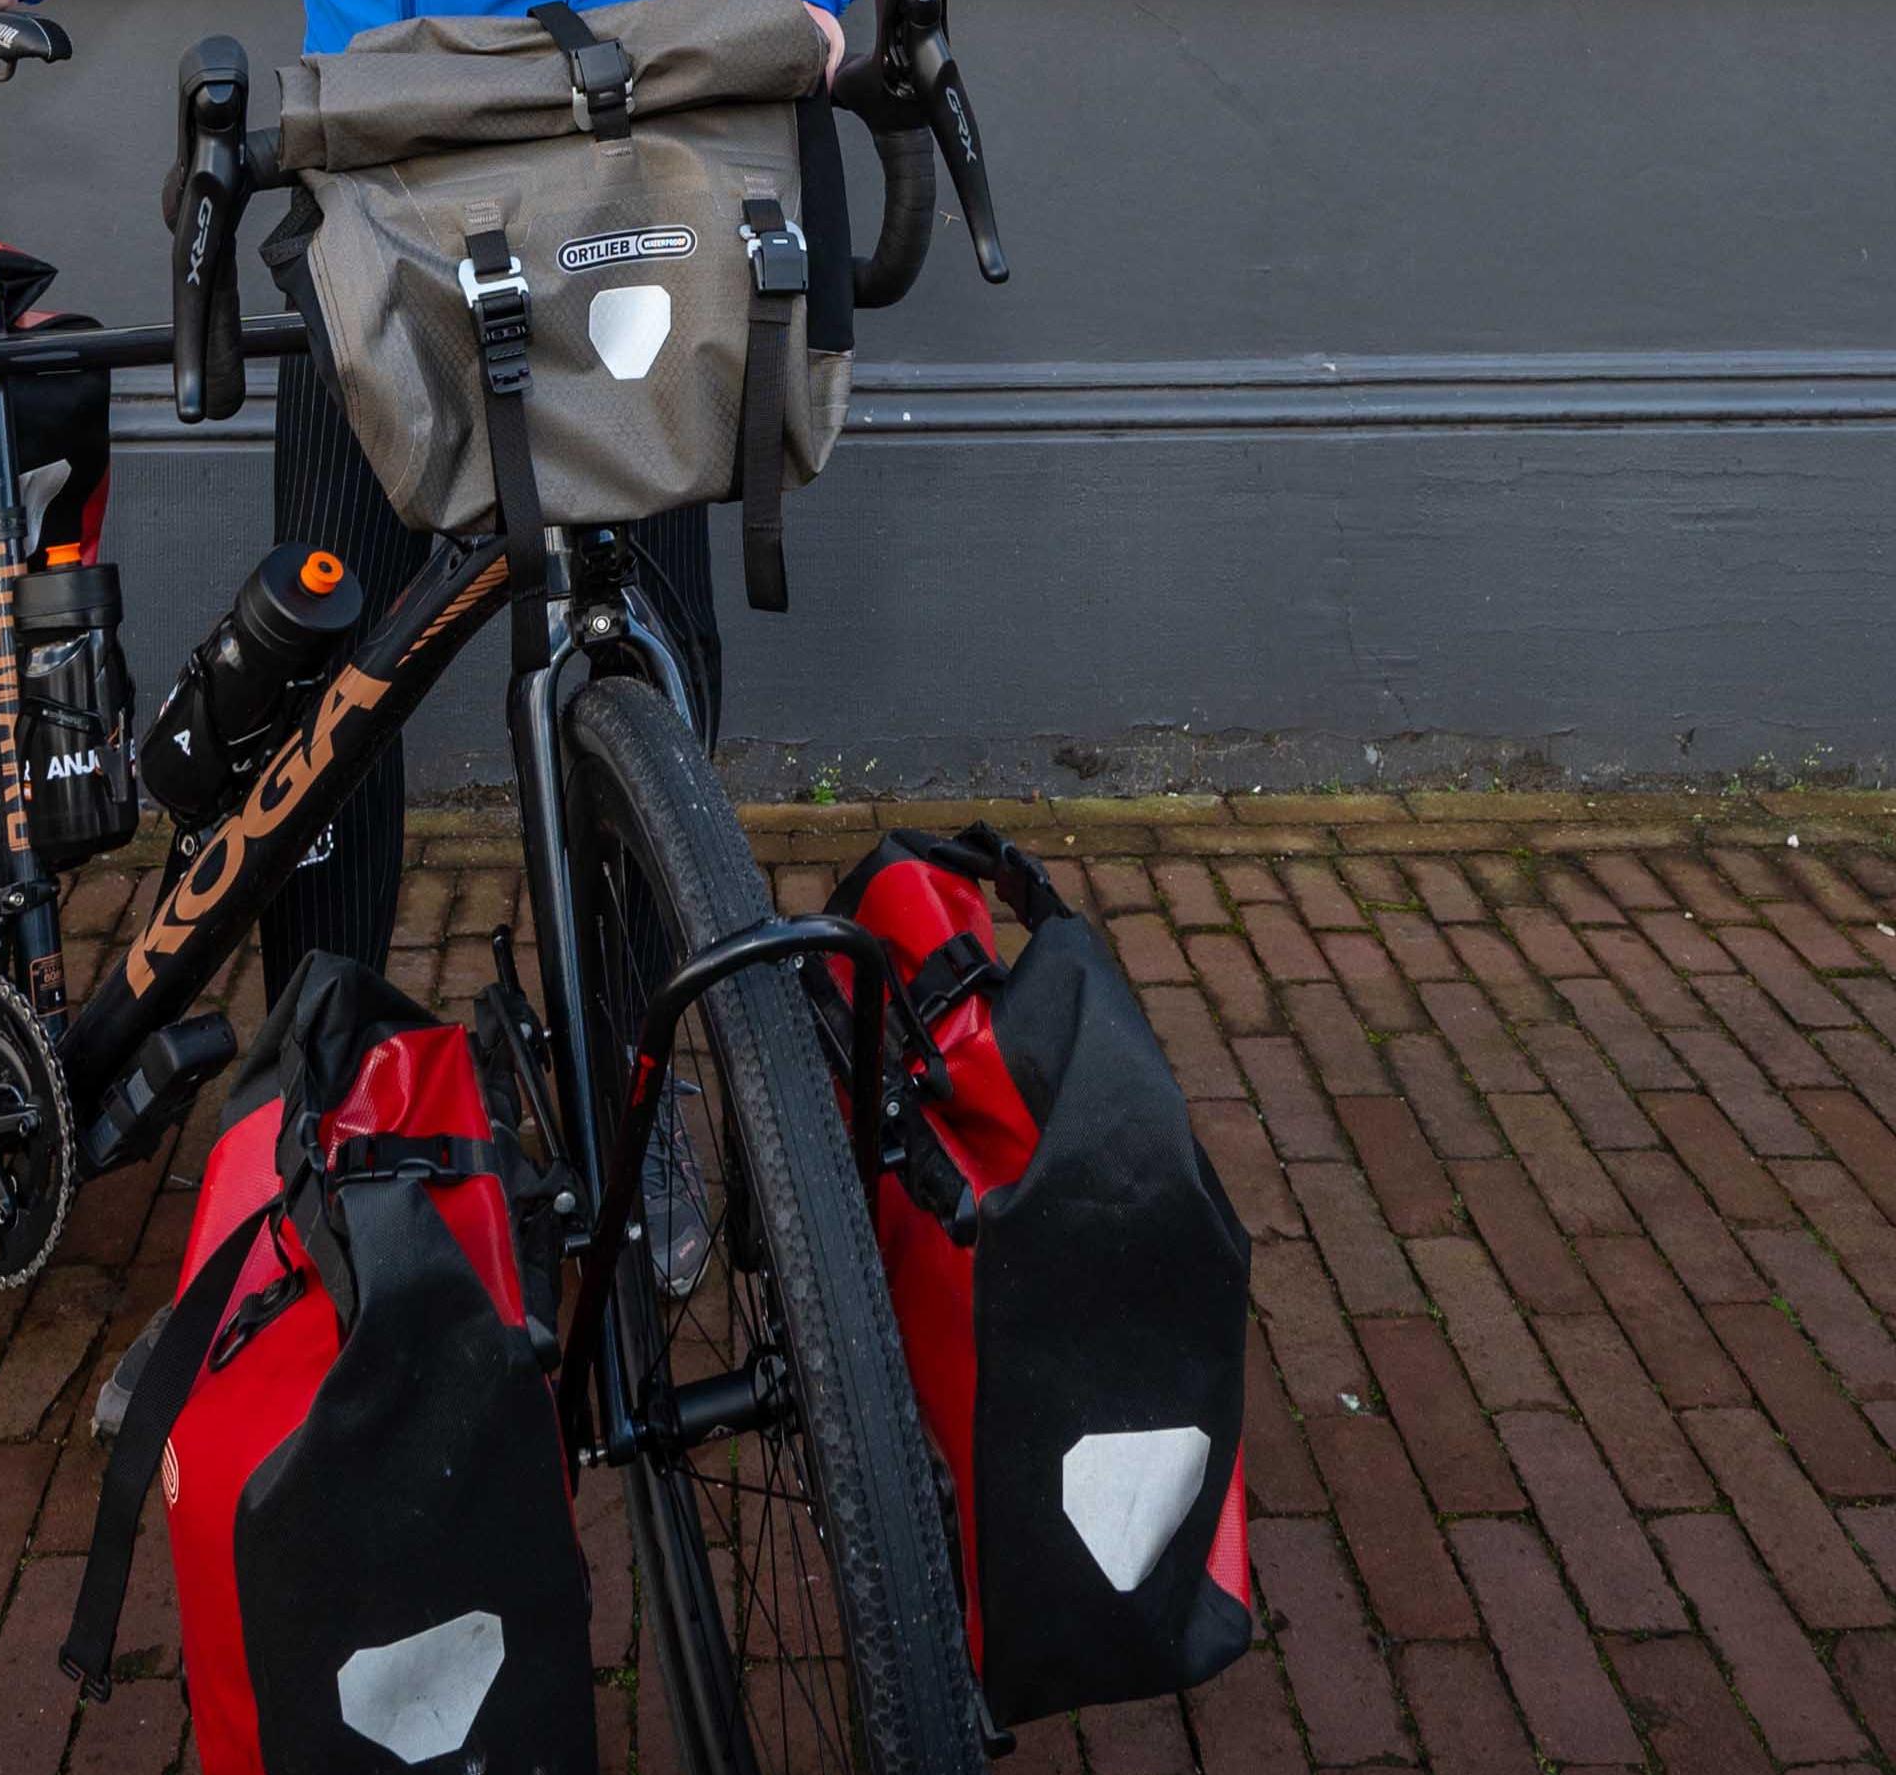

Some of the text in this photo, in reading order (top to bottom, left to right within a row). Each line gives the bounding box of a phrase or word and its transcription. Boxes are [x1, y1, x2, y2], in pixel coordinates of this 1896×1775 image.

[946, 87, 976, 163] GRX
[187, 197, 213, 286] GRX
[566, 240, 630, 264] ORTLIEB
[125, 663, 392, 999] KOGA
